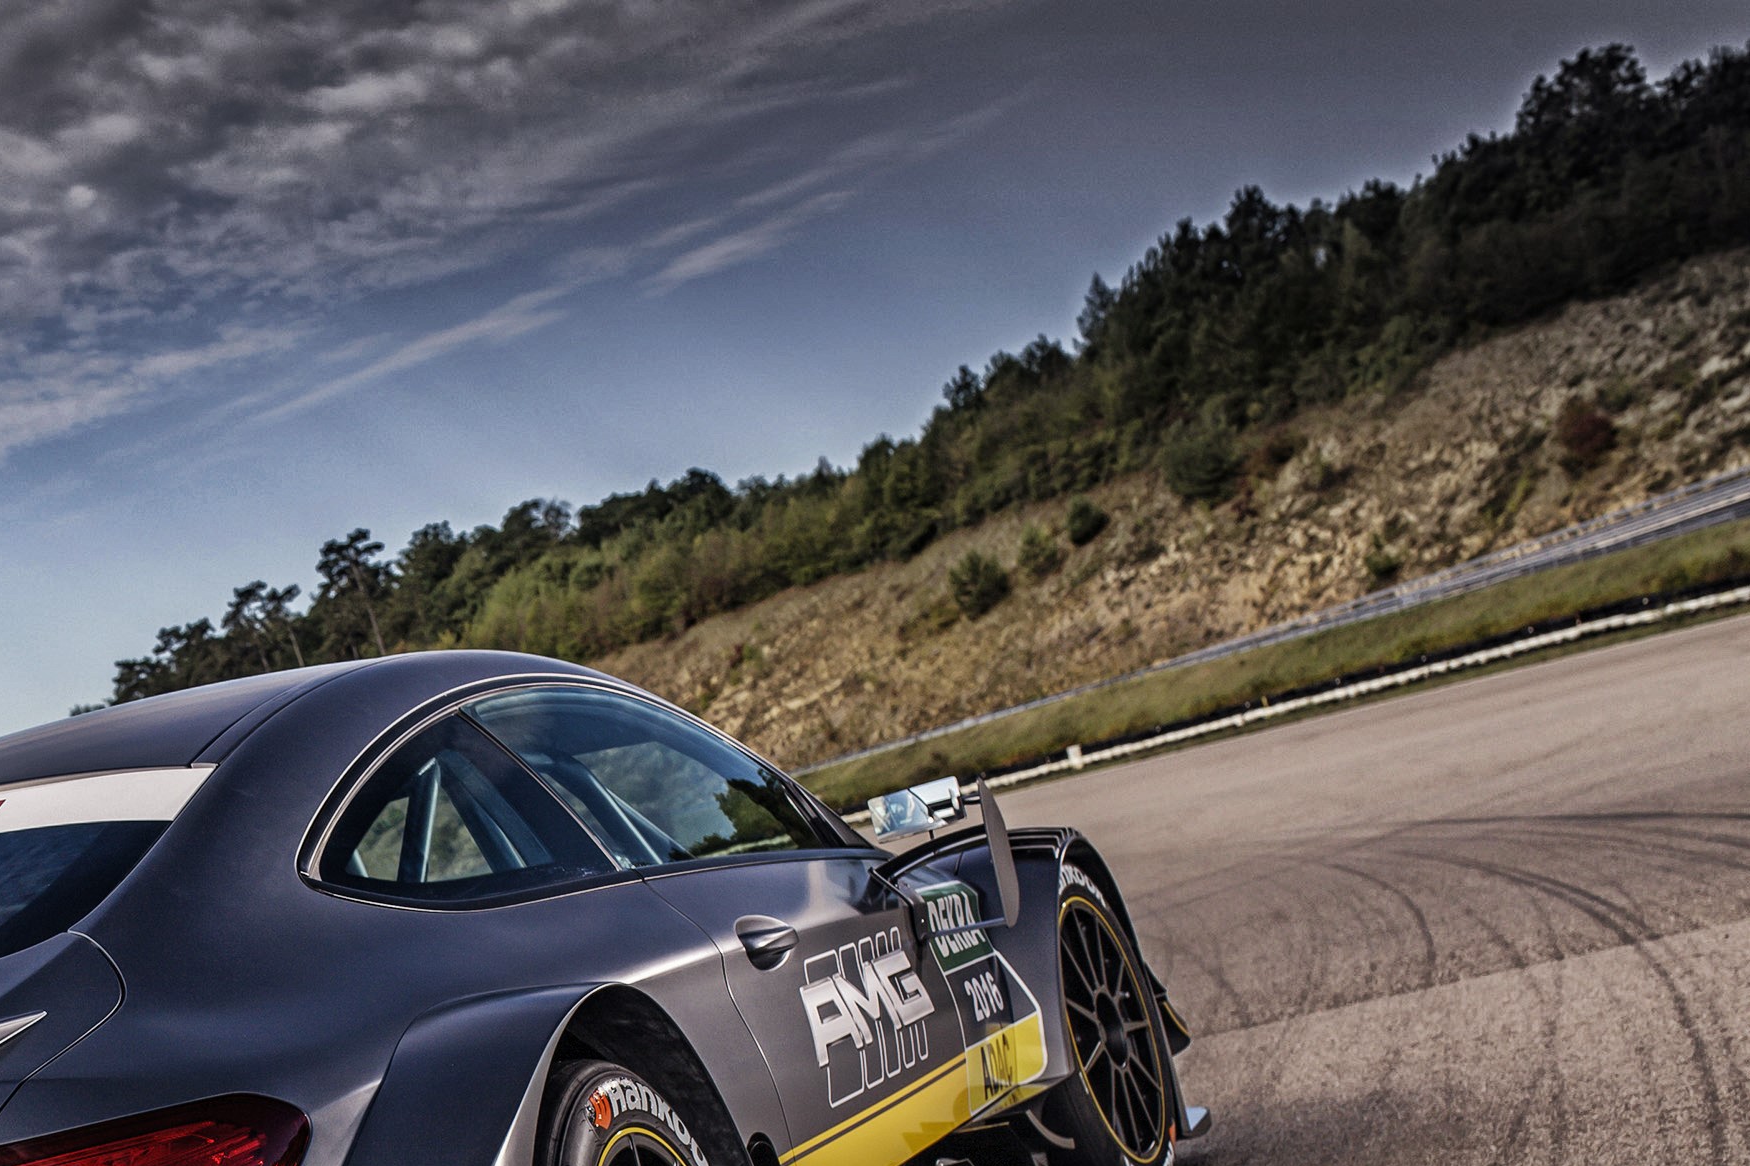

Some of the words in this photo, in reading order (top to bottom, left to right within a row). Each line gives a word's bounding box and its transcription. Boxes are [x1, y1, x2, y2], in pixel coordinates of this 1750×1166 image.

[926, 891, 986, 958] DEKRA
[800, 950, 935, 1068] AMG
[964, 971, 1005, 1023] 2016
